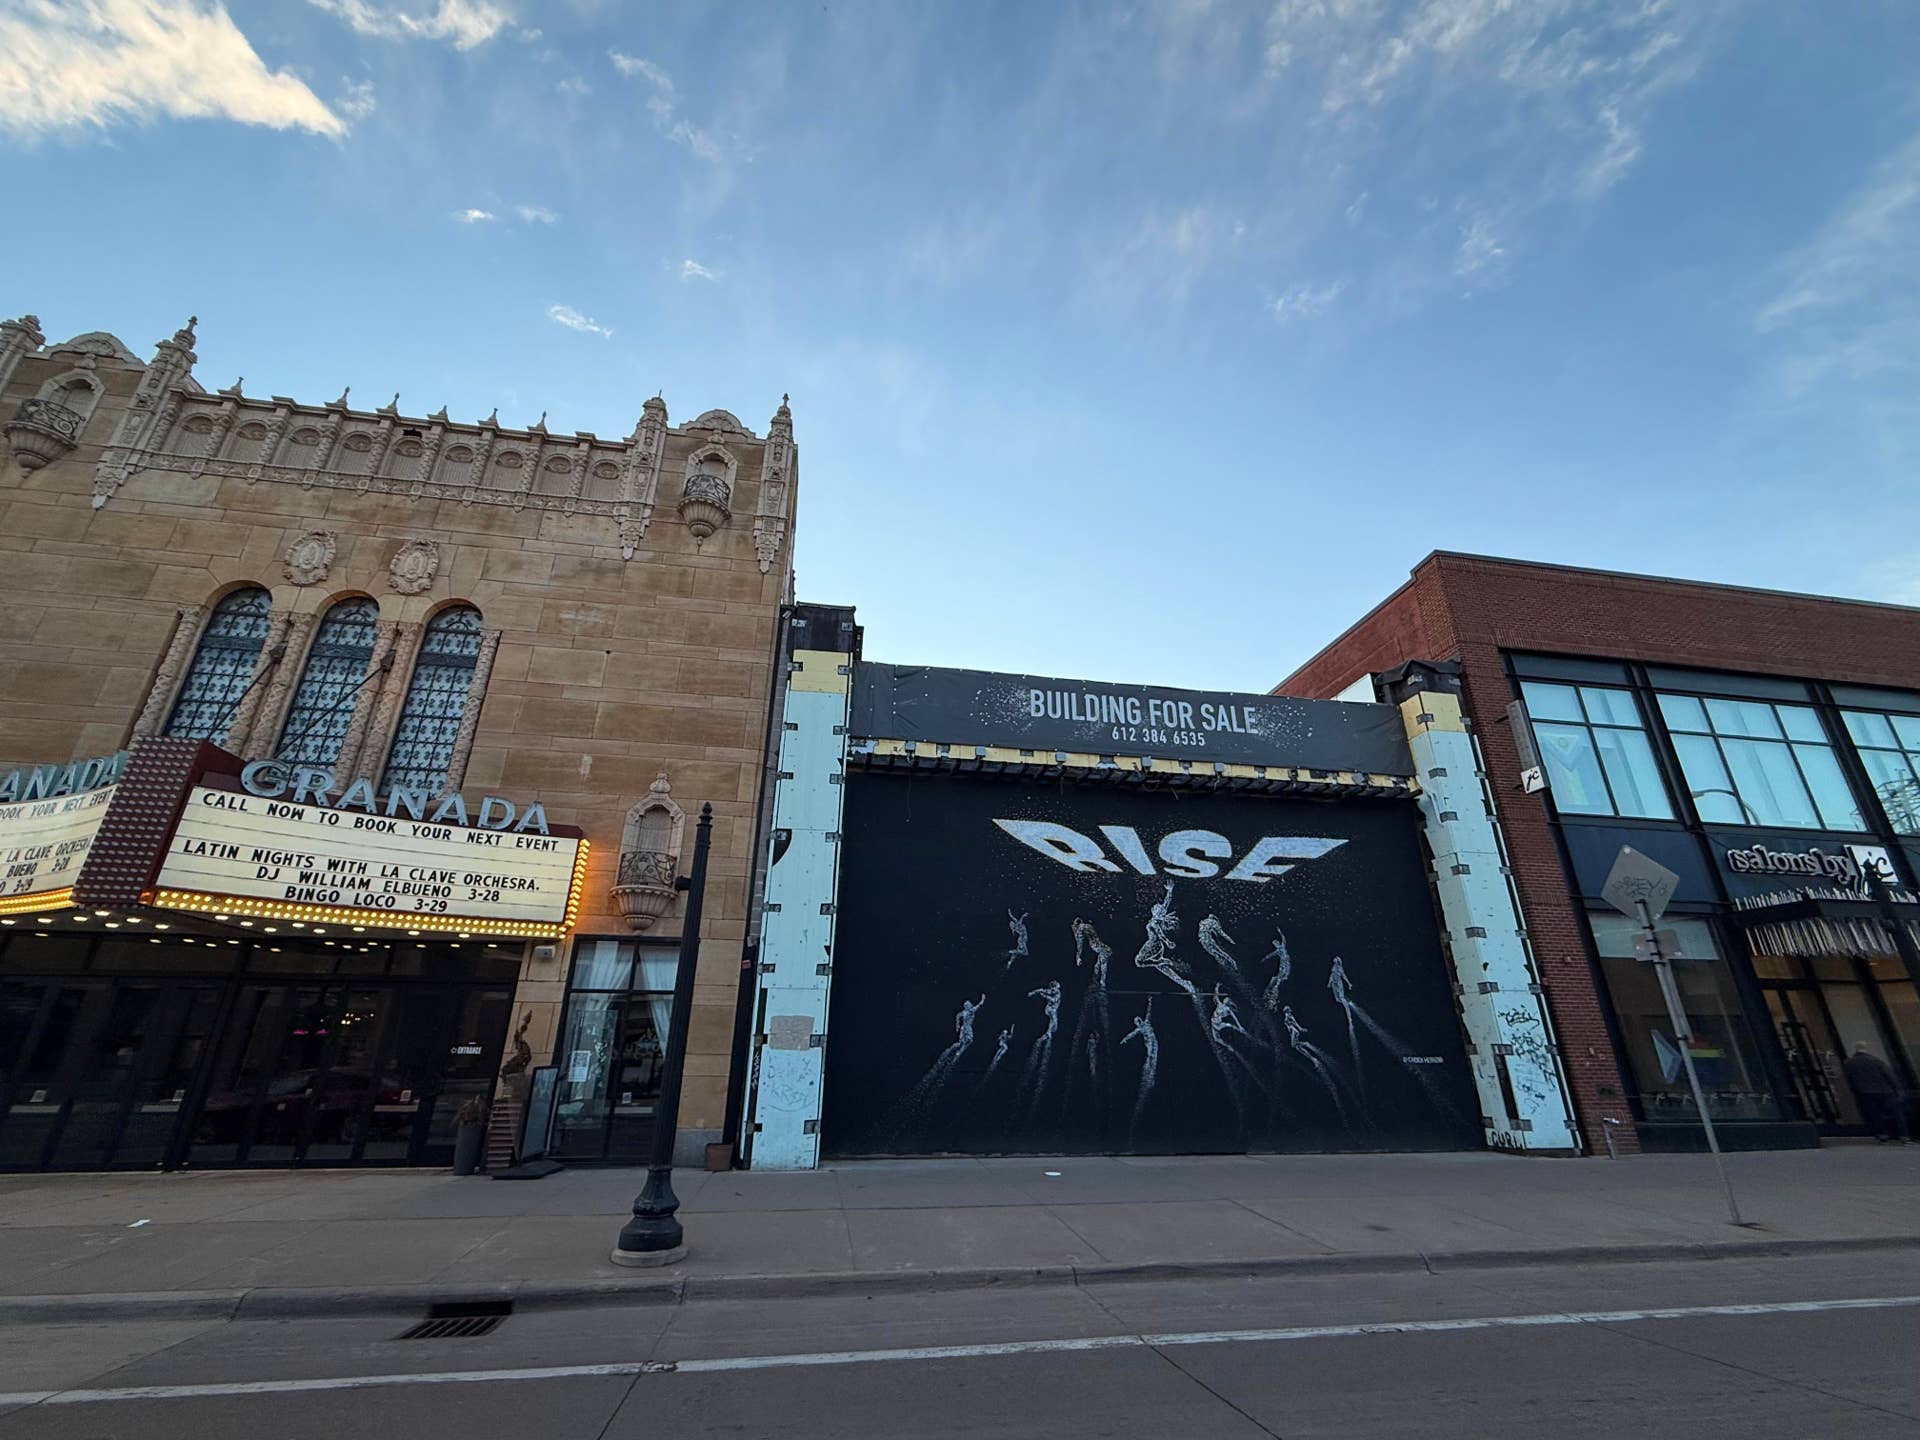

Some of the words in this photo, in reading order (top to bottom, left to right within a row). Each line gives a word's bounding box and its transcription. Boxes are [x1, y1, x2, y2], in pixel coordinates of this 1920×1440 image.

[1030, 688, 1141, 725] BUILDING
[1149, 699, 1195, 730] FOR
[1201, 703, 1259, 734] SALE
[1112, 726, 1136, 742] 612
[1143, 728, 1167, 744] 384
[1173, 730, 1206, 746] 6535
[203, 792, 248, 812] CALL
[267, 802, 304, 820] NOW
[320, 811, 339, 825] TO
[354, 816, 397, 834] BOOK
[412, 824, 451, 841] YOUR
[467, 831, 503, 847] NEXT
[516, 836, 559, 851] EVENT
[241, 759, 549, 835] GRANADA
[184, 839, 240, 859] LATIN
[252, 849, 315, 868] NIGHTS
[327, 858, 367, 875] WITH
[381, 865, 399, 879] LA
[409, 868, 457, 885] CLAVE
[463, 873, 540, 891] ORCHESRA.
[992, 818, 1349, 882] RISE
[256, 867, 280, 881] DJ
[299, 871, 371, 890] WILLIAM
[384, 880, 451, 898] ELBUENO
[468, 888, 500, 902] 3-28
[285, 885, 340, 903] BINGO
[354, 893, 396, 908] LOCO
[414, 898, 448, 912] 3-29
